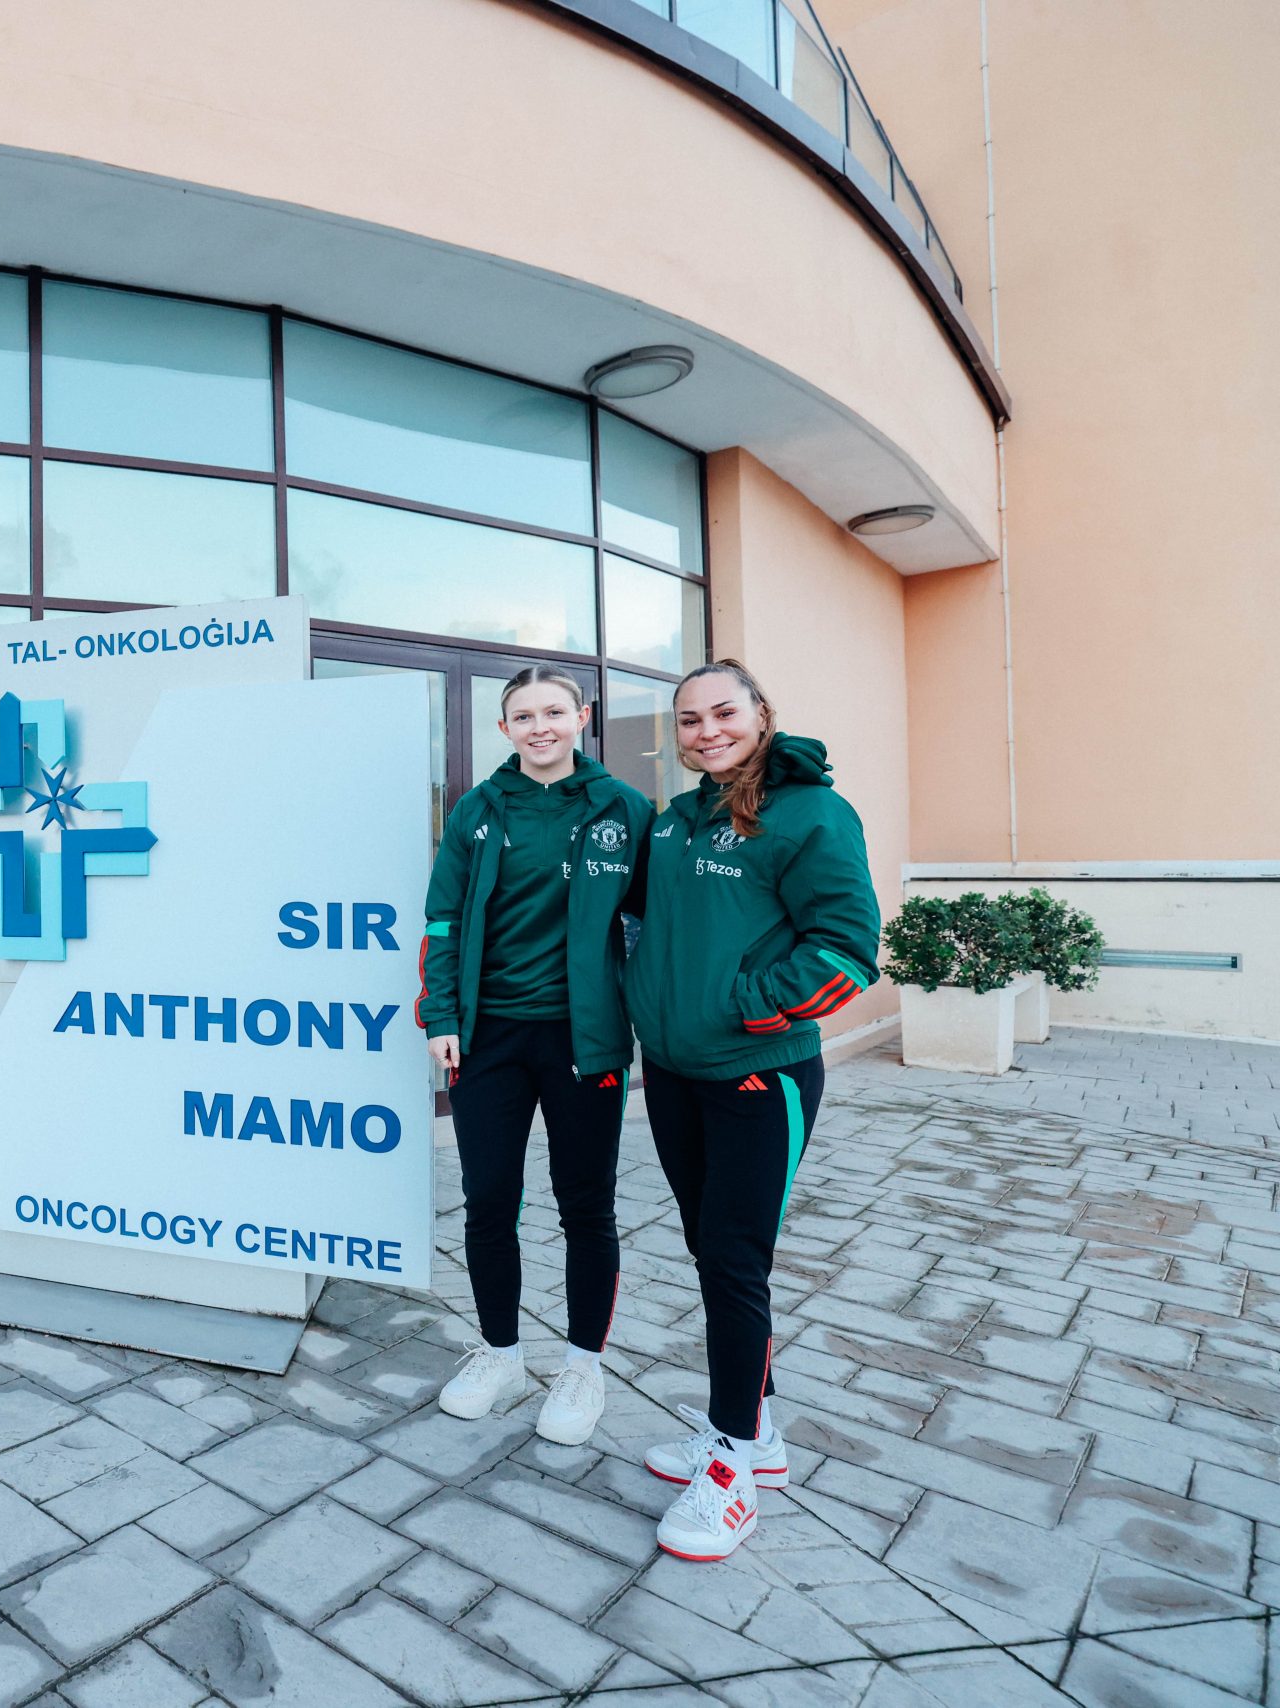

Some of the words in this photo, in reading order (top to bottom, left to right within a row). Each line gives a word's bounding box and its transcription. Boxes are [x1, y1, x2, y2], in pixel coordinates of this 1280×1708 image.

[7, 640, 67, 665] TAL-
[75, 617, 275, 660] ONKOLOĠIJA
[600, 861, 630, 874] Tezos
[706, 860, 743, 878] Tezos
[277, 901, 401, 952] SIR
[52, 990, 401, 1053] ANTHONY
[183, 1090, 402, 1154] MAMO
[15, 1194, 223, 1248] ONCOLOGY
[235, 1223, 403, 1273] CENTRE
